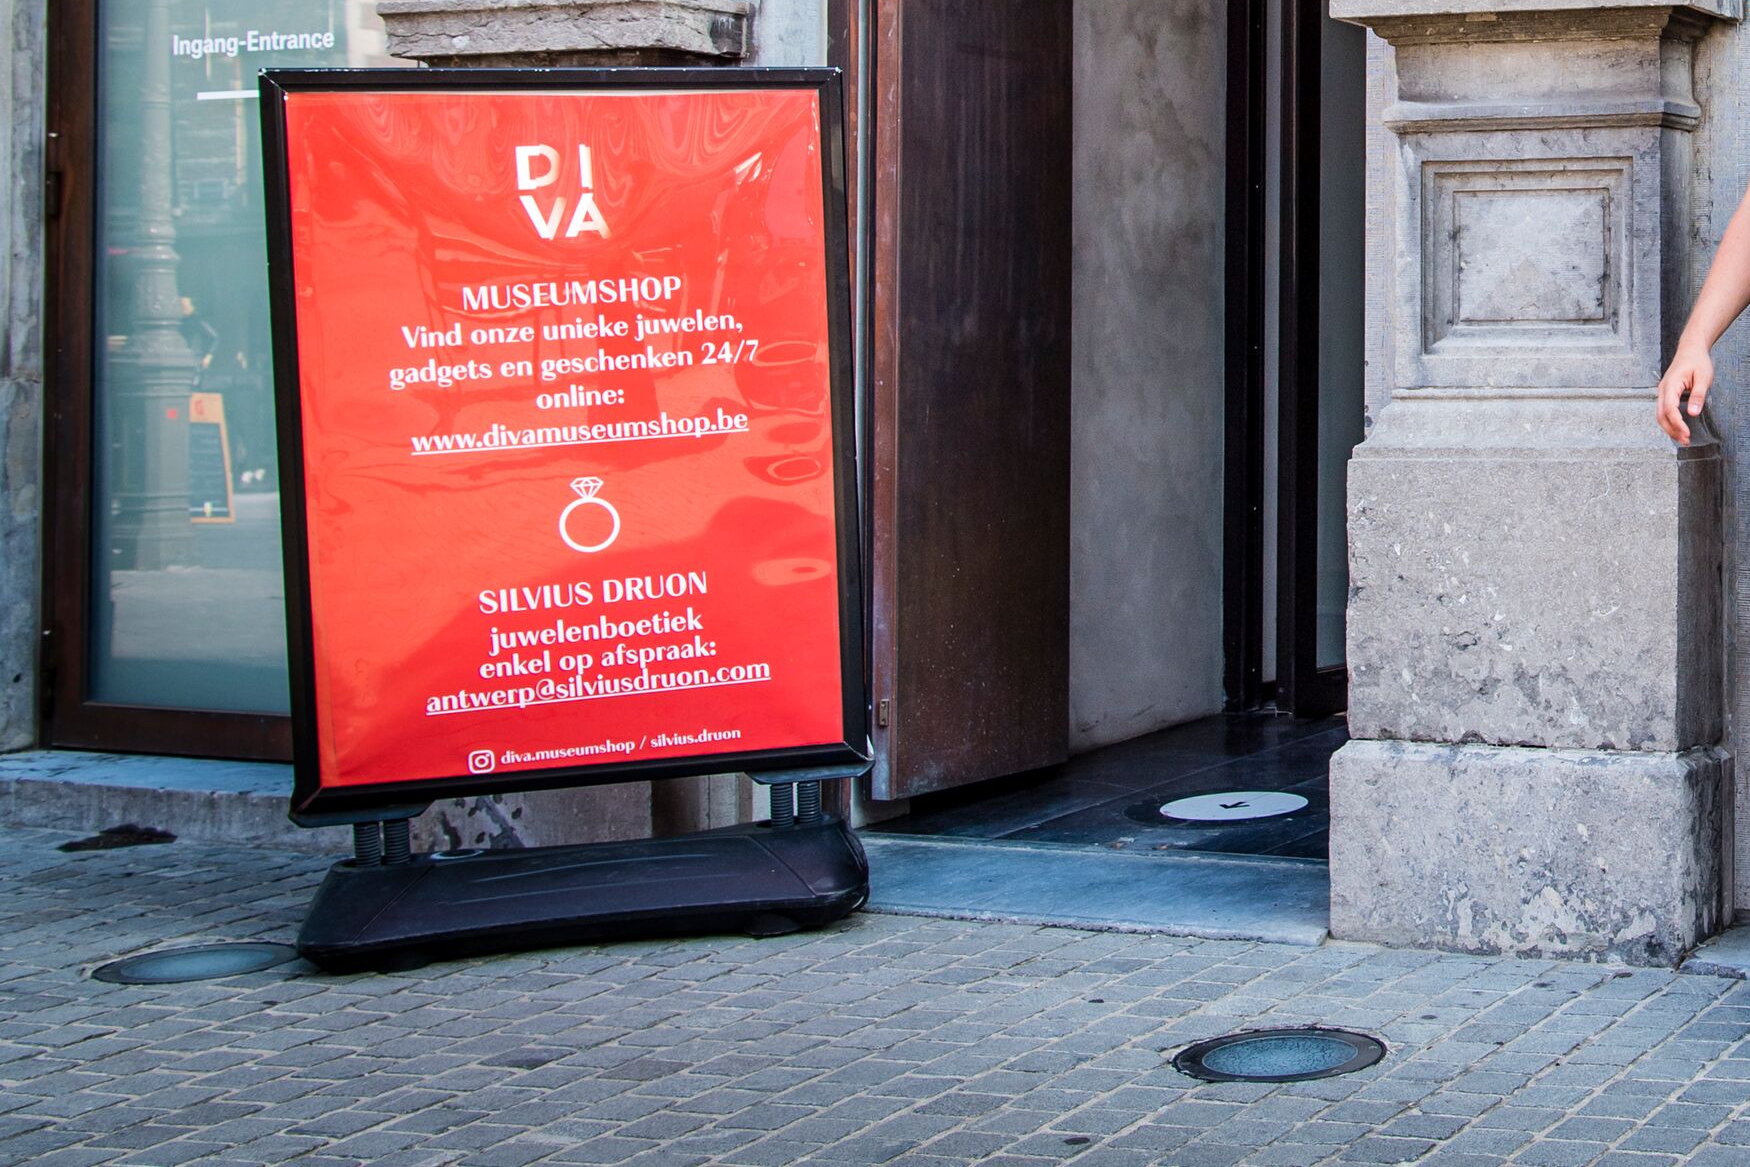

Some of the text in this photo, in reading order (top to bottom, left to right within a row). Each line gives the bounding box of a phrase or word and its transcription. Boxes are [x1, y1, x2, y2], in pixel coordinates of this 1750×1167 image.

[172, 31, 335, 59] Ingang-Entrance
[515, 144, 593, 192] DI
[519, 191, 610, 240] VA
[462, 275, 682, 311] MUSEUMSHOP
[401, 308, 744, 349] Vind onze unieke juwelen,
[389, 339, 759, 390] gadgets en geschenken 24/7
[536, 384, 625, 409] online:
[411, 407, 750, 456] www.divamuseumshop.be
[479, 571, 708, 614] SILVIUS DRUON
[488, 607, 703, 656] juwelenboetiek
[479, 635, 717, 679] enkel op afspraak:
[426, 662, 771, 715] antwerp@silviusdruon.com
[500, 739, 636, 765] diva.museumshop
[650, 728, 742, 748] silvius.druon
